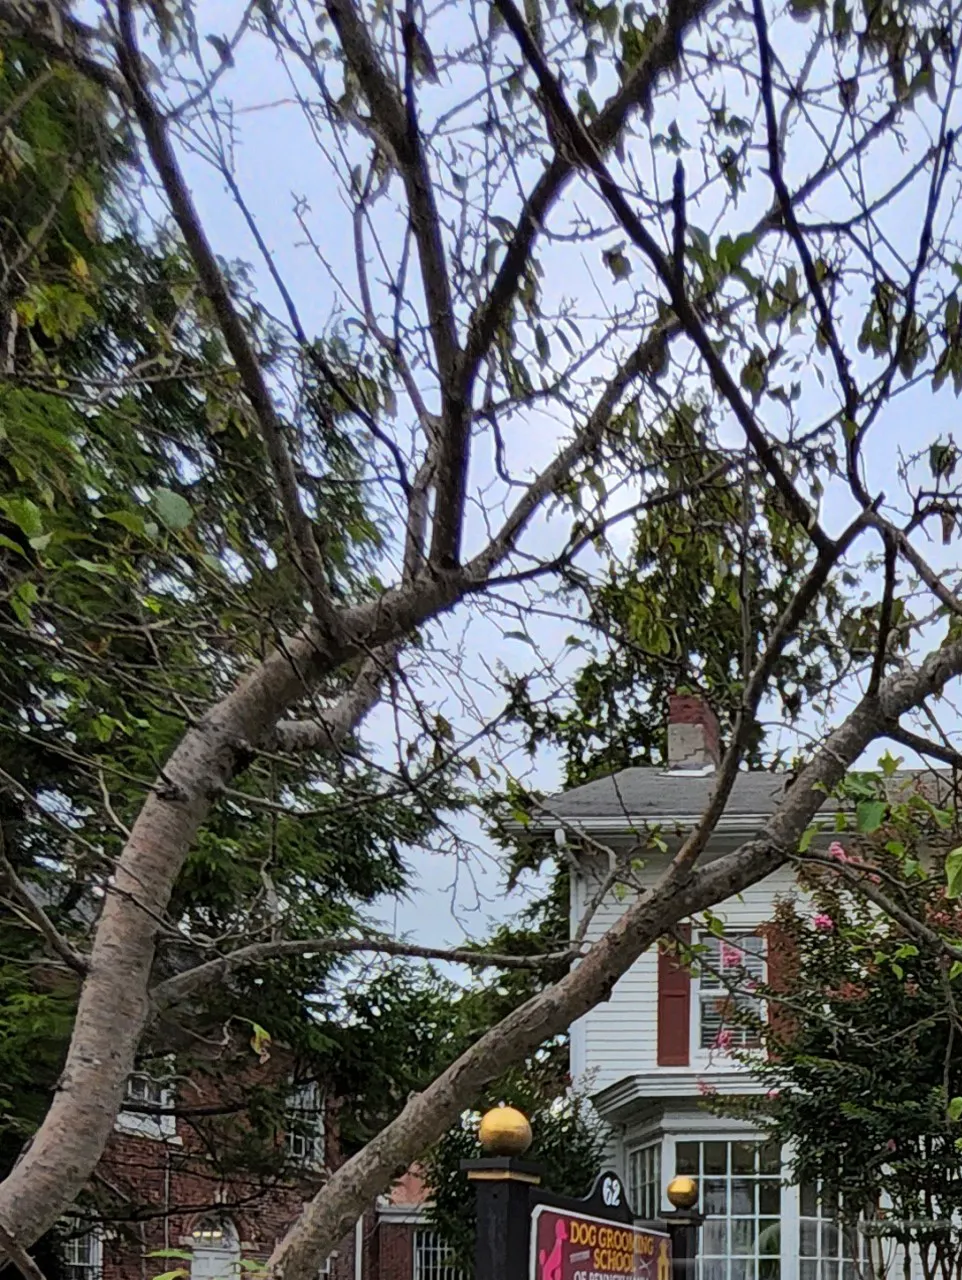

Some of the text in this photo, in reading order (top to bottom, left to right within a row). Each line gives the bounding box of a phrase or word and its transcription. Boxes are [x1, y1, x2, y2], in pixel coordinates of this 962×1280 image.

[603, 1177, 620, 1206] 62
[570, 1221, 654, 1255] DOG GROOMING
[593, 1248, 636, 1272] SCHOOL
